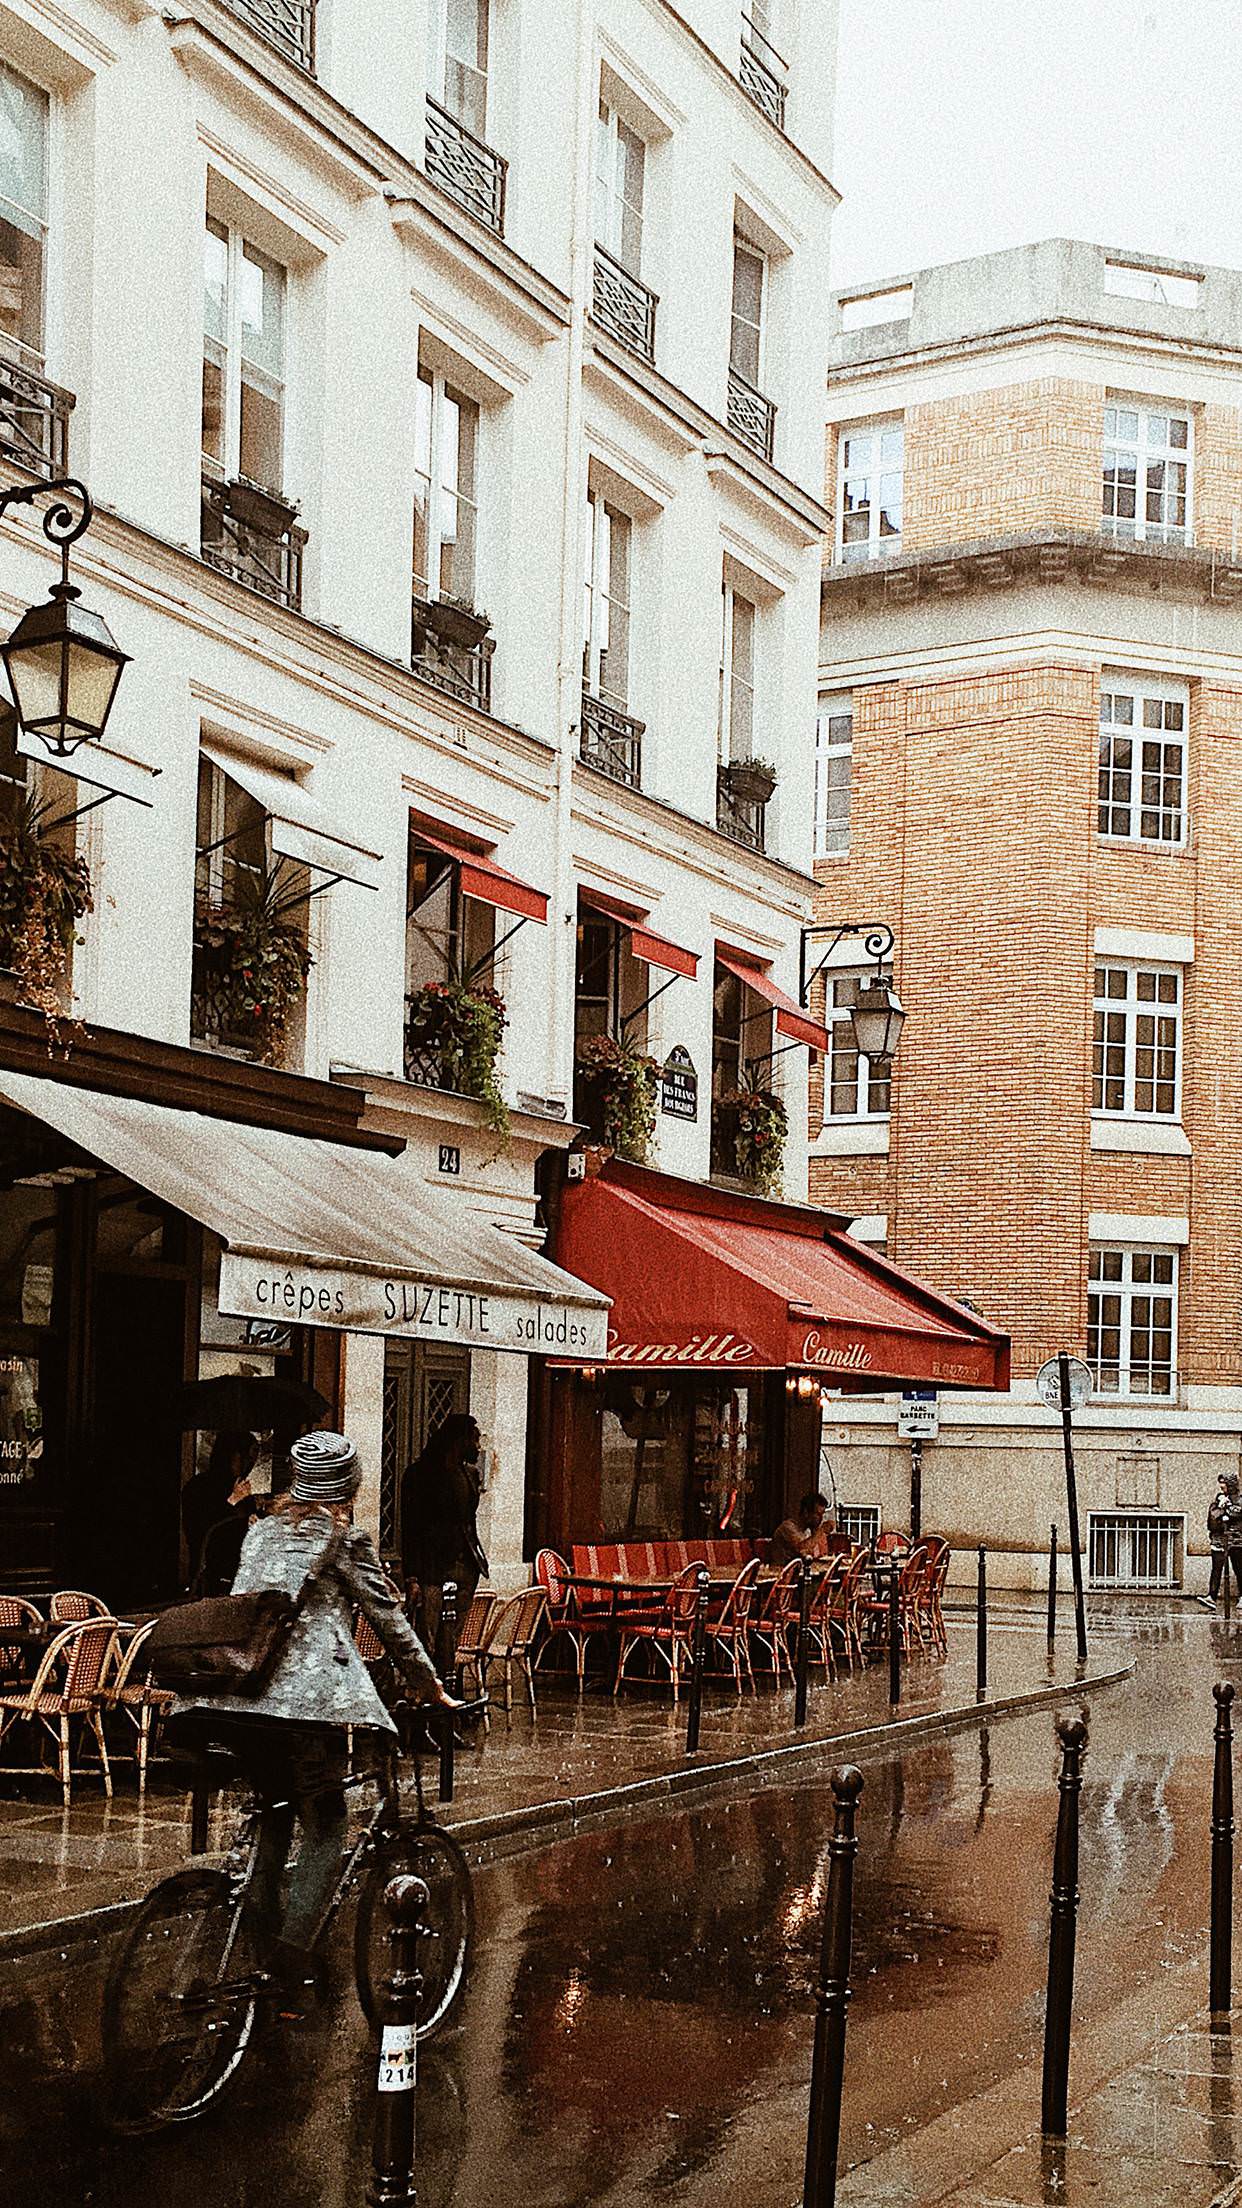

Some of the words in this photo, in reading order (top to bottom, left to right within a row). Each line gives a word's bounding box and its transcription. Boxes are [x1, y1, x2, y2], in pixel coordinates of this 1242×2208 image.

[441, 1148, 458, 1173] 24
[255, 1272, 344, 1318] crêpes
[384, 1282, 490, 1333] SUZETTE
[516, 1306, 588, 1346] salades
[802, 1330, 873, 1370] Camille
